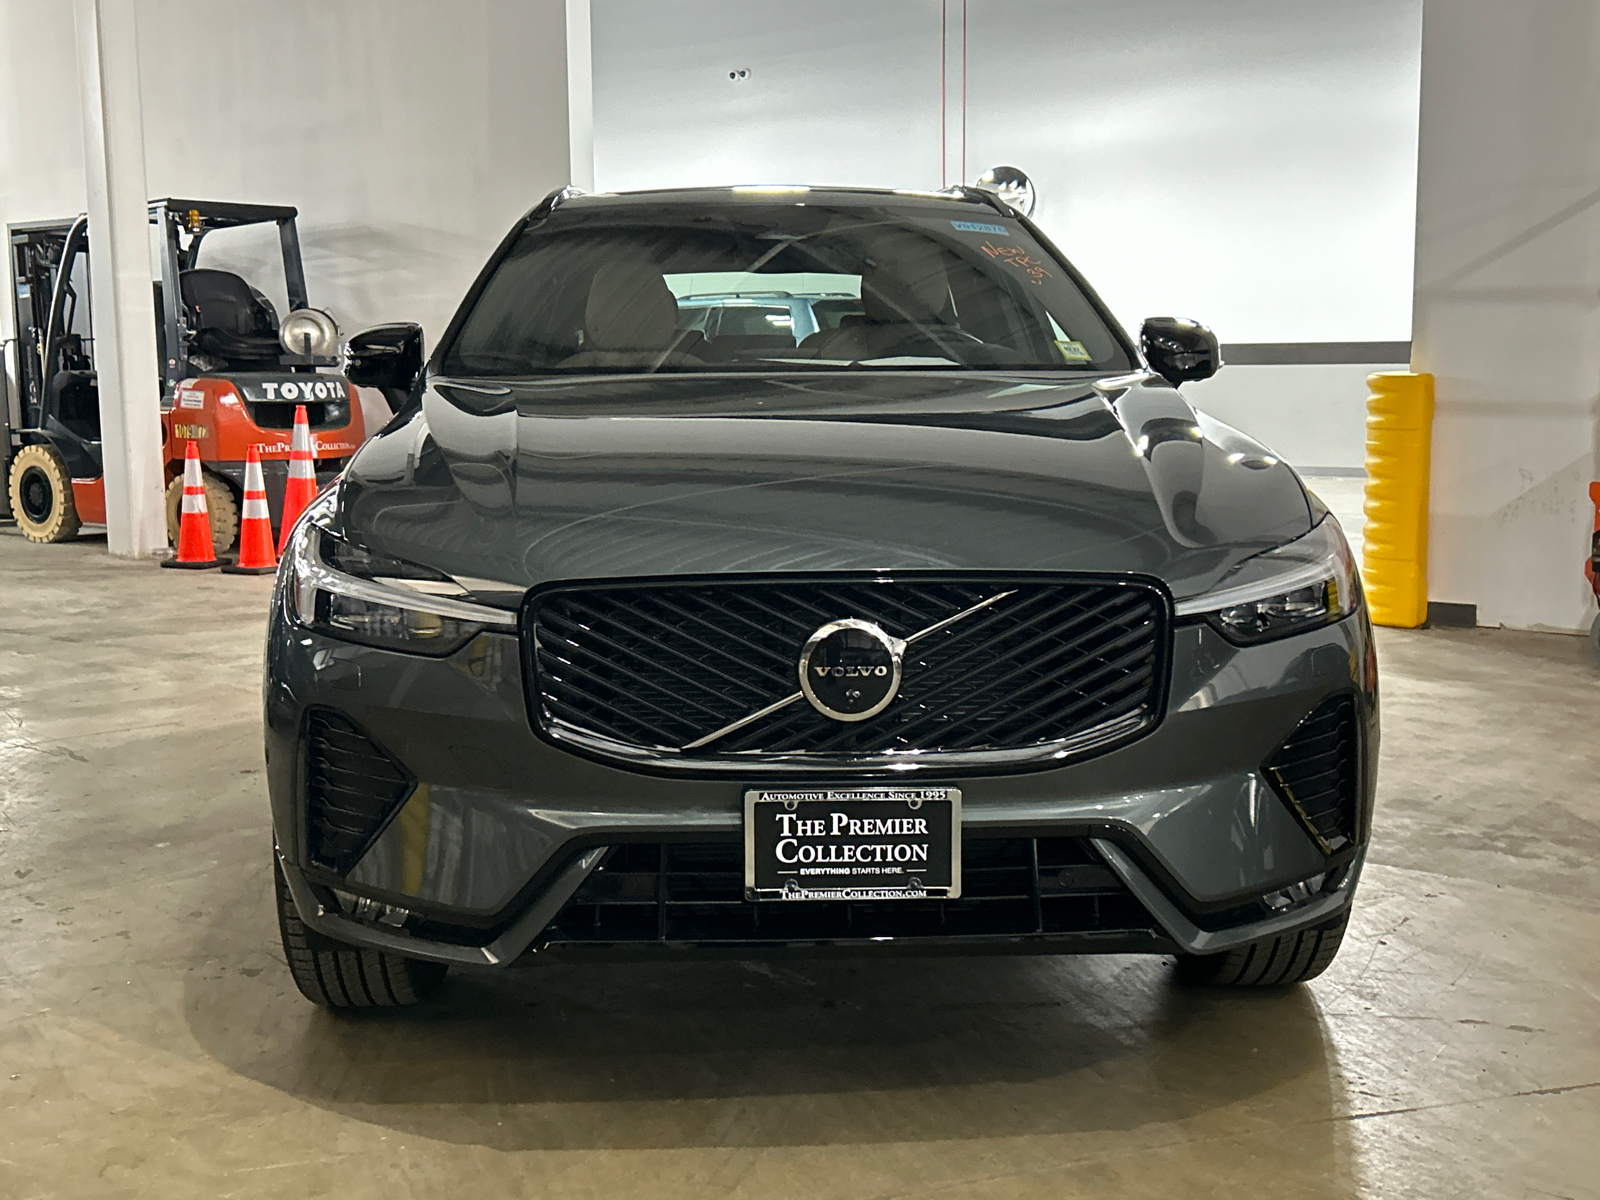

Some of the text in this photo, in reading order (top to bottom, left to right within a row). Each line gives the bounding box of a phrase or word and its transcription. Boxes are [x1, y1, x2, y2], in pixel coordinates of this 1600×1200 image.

[262, 382, 346, 400] TOYOTA
[814, 666, 888, 677] VOLVO
[762, 791, 946, 801] AUTOMOTIVE EXCELLENCE SINCE 1995
[775, 812, 929, 837] THE PREMIER
[775, 839, 929, 863] COLLECTION
[780, 889, 927, 900] THEPREMIERCOLLECTION.COM
